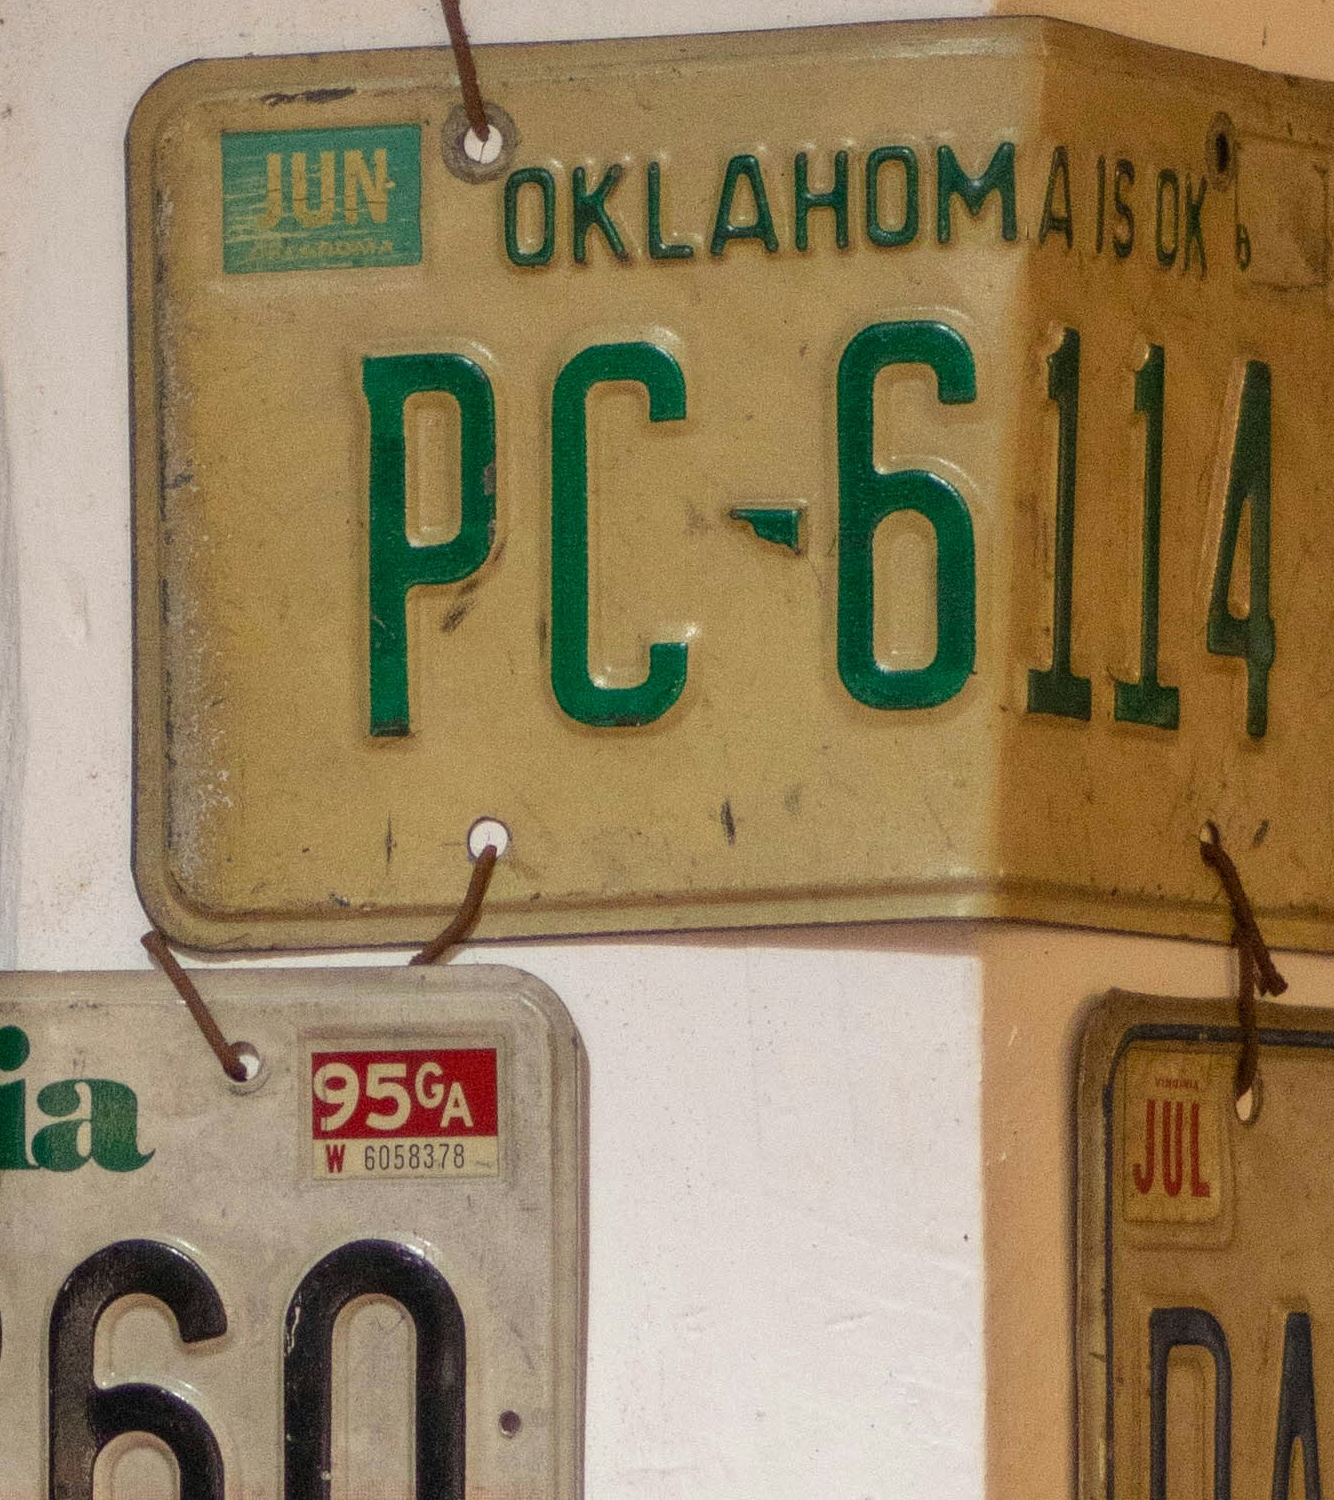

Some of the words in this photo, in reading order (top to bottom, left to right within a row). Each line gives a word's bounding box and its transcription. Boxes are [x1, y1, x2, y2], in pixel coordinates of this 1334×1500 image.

[257, 147, 388, 229] JUN
[502, 139, 1073, 269] OKLAHOMA
[1095, 154, 1135, 259] IS
[1155, 166, 1208, 281] OK
[362, 320, 1275, 739] PC-6114
[325, 1143, 347, 1174] W
[364, 1142, 465, 1172] 6058378
[1132, 1099, 1211, 1198] JUL
